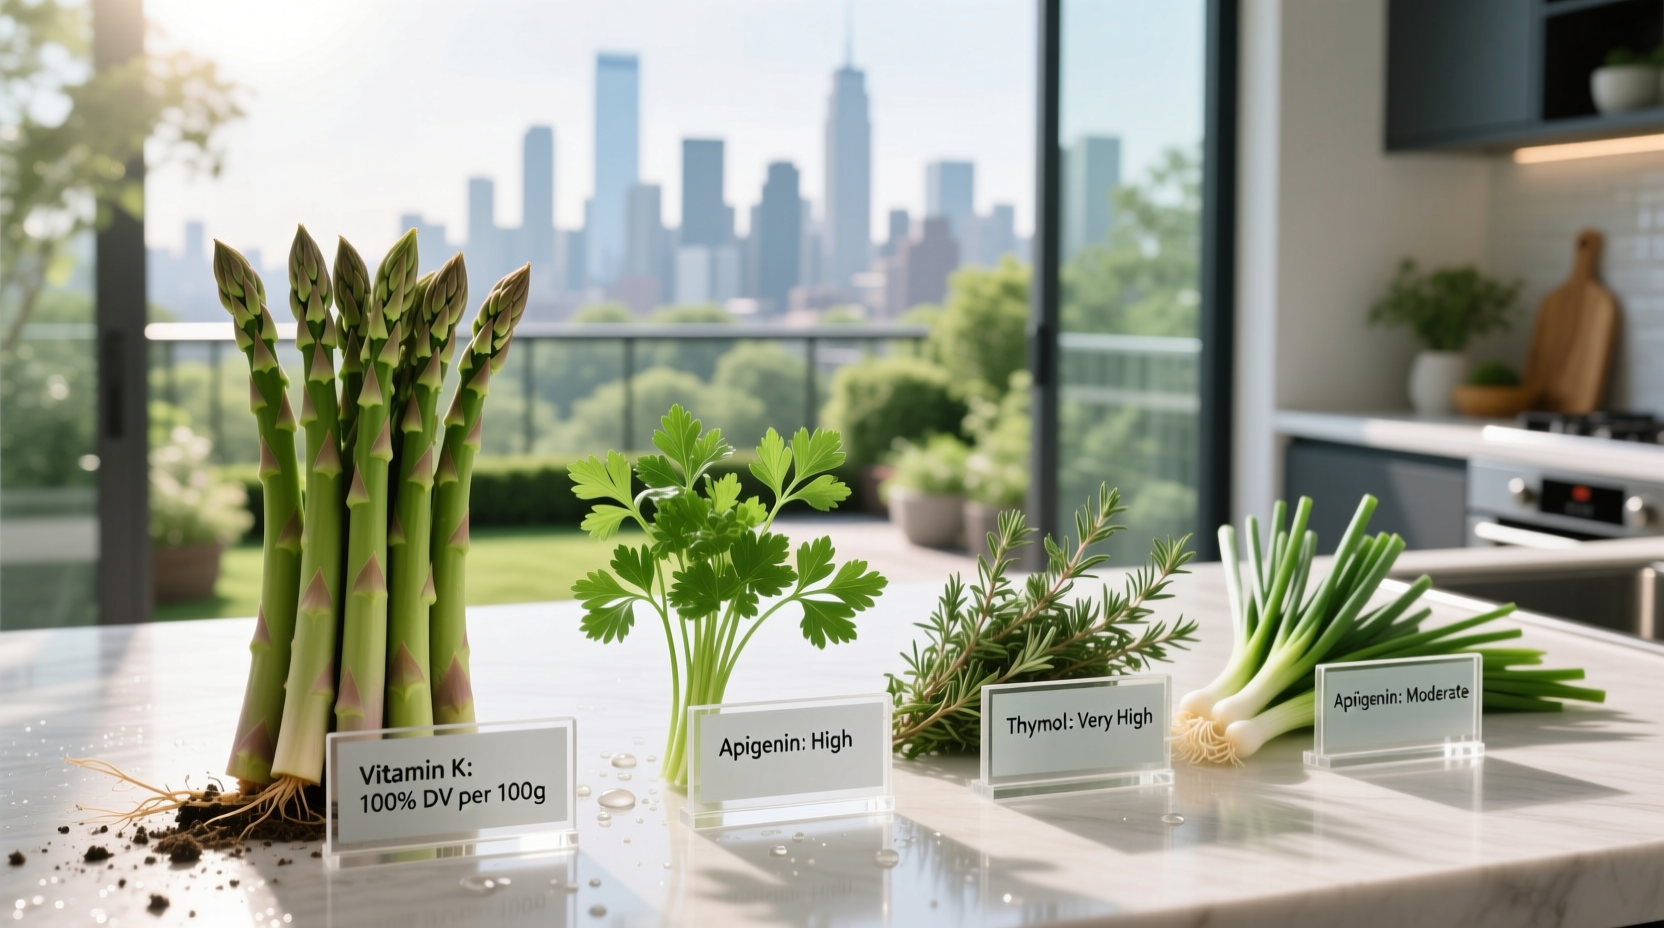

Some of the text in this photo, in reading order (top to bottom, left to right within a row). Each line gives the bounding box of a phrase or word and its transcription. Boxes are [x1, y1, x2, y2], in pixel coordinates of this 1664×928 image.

[1406, 684, 1470, 704] Moderate
[1006, 706, 1153, 739] Thymol: Very High
[719, 729, 853, 761] Apigenin: High
[359, 758, 473, 785] Vitamin K:
[360, 781, 546, 813] 100% DV per 100g
